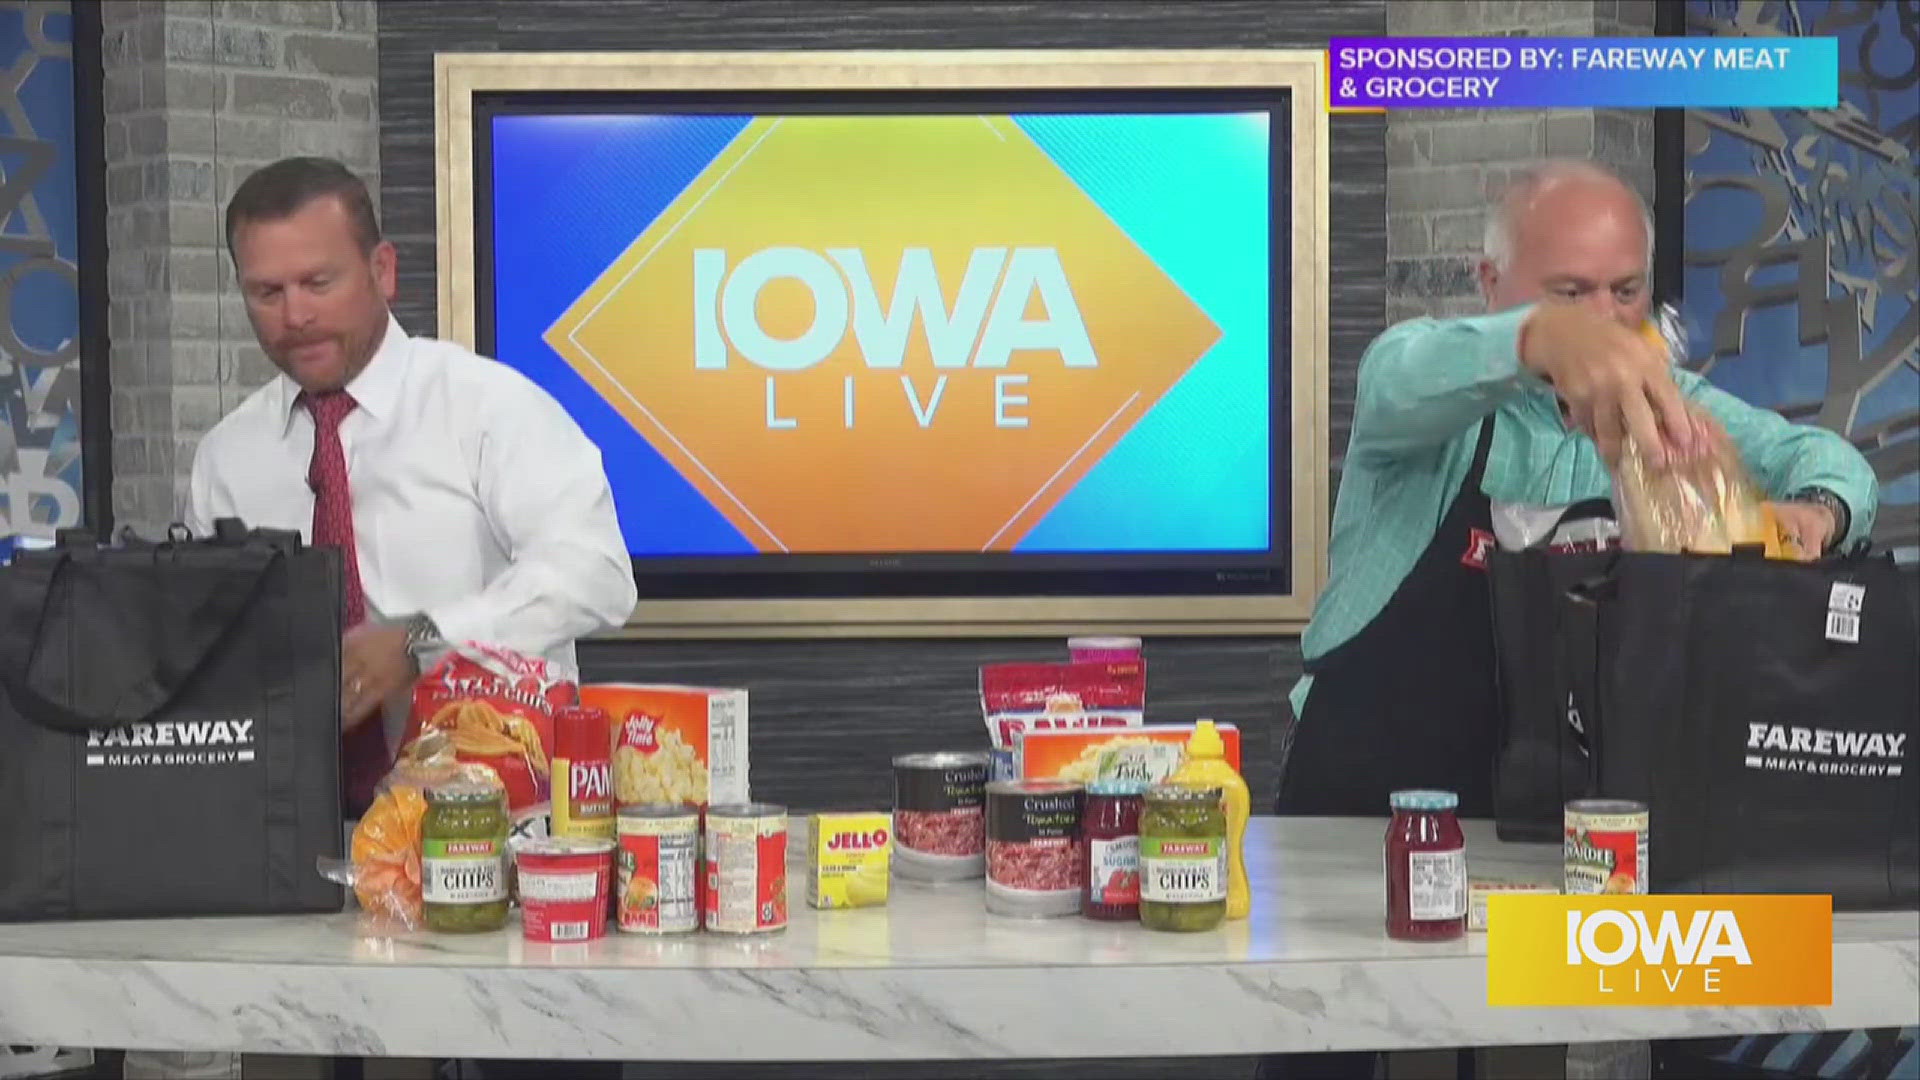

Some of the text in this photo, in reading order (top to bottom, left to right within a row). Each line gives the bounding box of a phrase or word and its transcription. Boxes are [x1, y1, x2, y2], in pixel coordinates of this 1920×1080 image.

[694, 246, 1098, 369] IOWA
[766, 374, 1029, 428] LIVE
[625, 714, 654, 732] Jolly
[628, 730, 653, 747] Time
[1748, 722, 1905, 757] FAREWAY
[1024, 795, 1075, 811] Crushed
[448, 843, 491, 854] FAREWAY
[1164, 843, 1205, 855] FAREWAY
[444, 873, 494, 890] CHIPS
[1160, 873, 1209, 890] CHIPS
